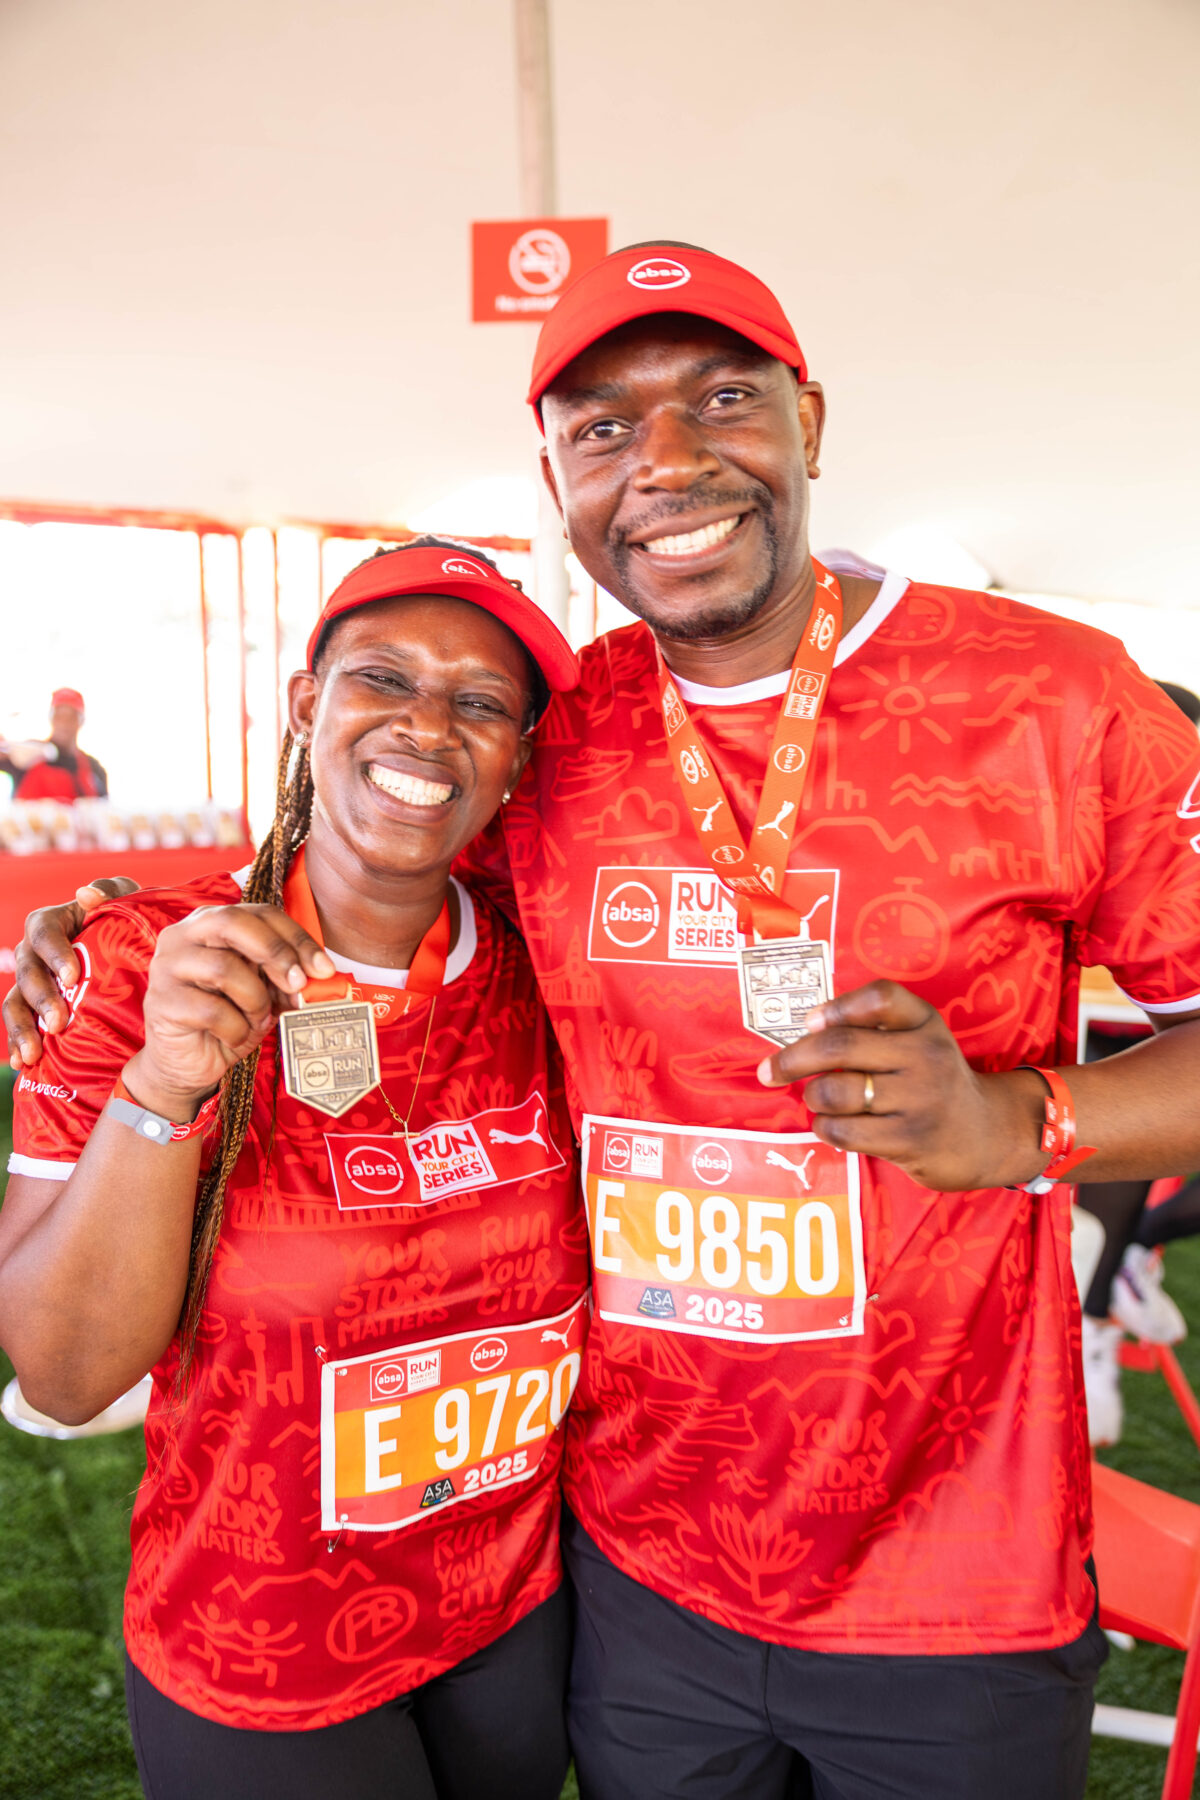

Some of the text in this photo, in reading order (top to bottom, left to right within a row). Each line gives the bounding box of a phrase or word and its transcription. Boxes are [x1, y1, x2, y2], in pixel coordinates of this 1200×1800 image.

[634, 267, 684, 280] absa
[808, 607, 826, 647] CHERY
[783, 747, 798, 770] absa
[608, 900, 653, 922] absa
[677, 881, 737, 913] RUN
[678, 914, 735, 928] YOUR CITY
[675, 927, 736, 948] SERIES
[334, 1057, 362, 1072] RUN
[351, 1129, 477, 1177] absa RUN
[421, 1151, 477, 1173] YOUR CITY
[608, 1143, 658, 1157] absa RUN
[696, 1154, 729, 1170] absa
[423, 1161, 483, 1190] SERIES
[479, 1210, 550, 1259] RUN
[594, 1179, 625, 1273] E
[655, 1190, 839, 1296] 9850
[341, 1228, 449, 1282] YOUR
[480, 1247, 552, 1287] YOUR
[334, 1270, 452, 1318] STORY
[477, 1279, 557, 1316] CITY
[641, 1289, 673, 1307] ASA
[685, 1294, 764, 1330] 2025
[338, 1306, 449, 1348] MATTERS
[378, 1373, 401, 1385] absa
[410, 1358, 437, 1375] RUN
[474, 1343, 503, 1361] absa
[364, 1405, 402, 1493] E
[434, 1352, 581, 1471] 9720
[787, 1409, 888, 1453] YOUR
[463, 1451, 528, 1493] 2025
[784, 1447, 892, 1489] STORY
[423, 1480, 452, 1501] ASA
[785, 1480, 890, 1515] MATTERS
[434, 1516, 498, 1568] RUN
[436, 1541, 505, 1594] YOUR
[438, 1568, 509, 1618] CITY
[345, 1594, 404, 1656] PB
